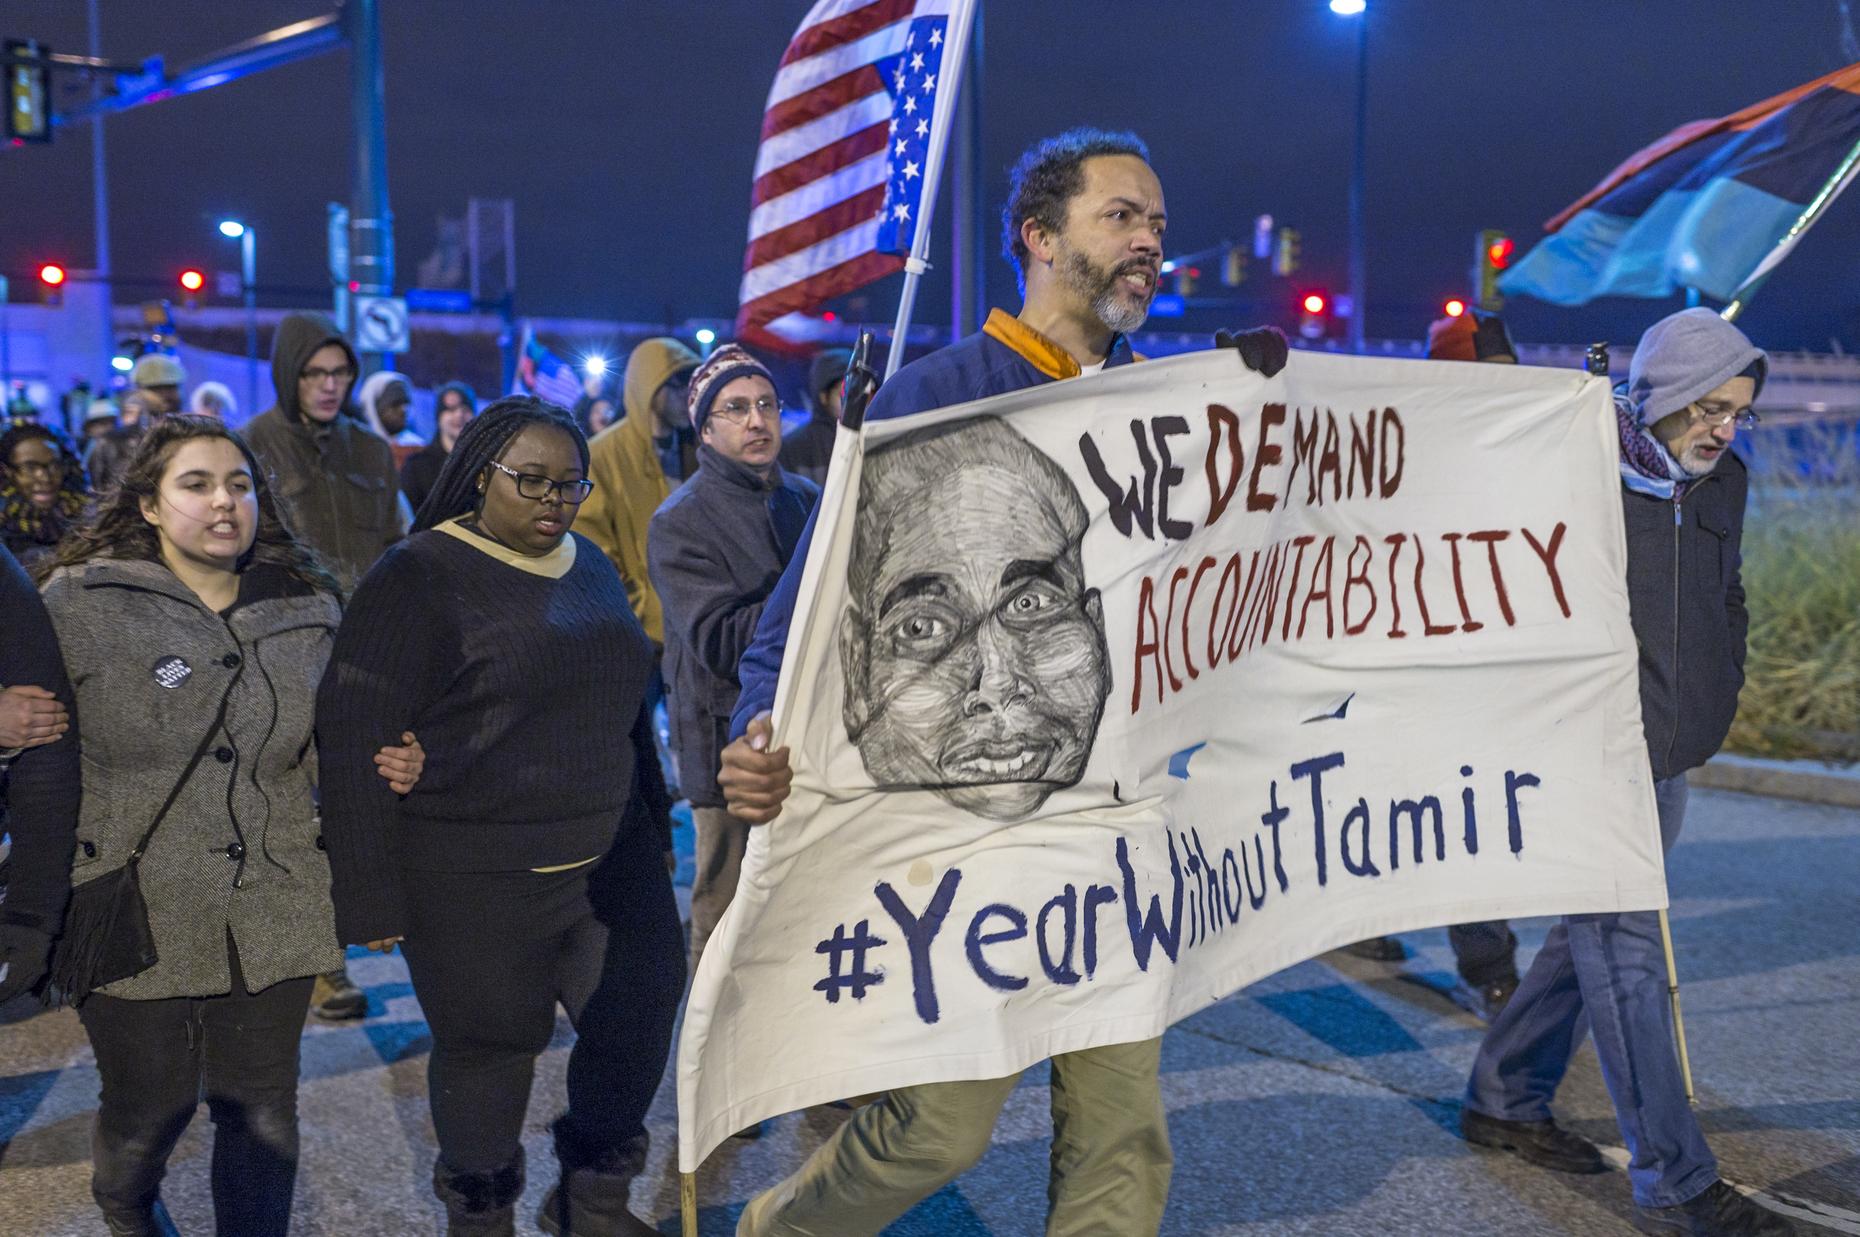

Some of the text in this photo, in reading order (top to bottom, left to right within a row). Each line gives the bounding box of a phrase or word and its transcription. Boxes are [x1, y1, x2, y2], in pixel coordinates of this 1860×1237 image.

[1079, 403, 1404, 540] WE DEMAND
[1131, 522, 1571, 714] ACCOUNTABILITY
[814, 752, 1541, 1024] #YearWithoutTamir
